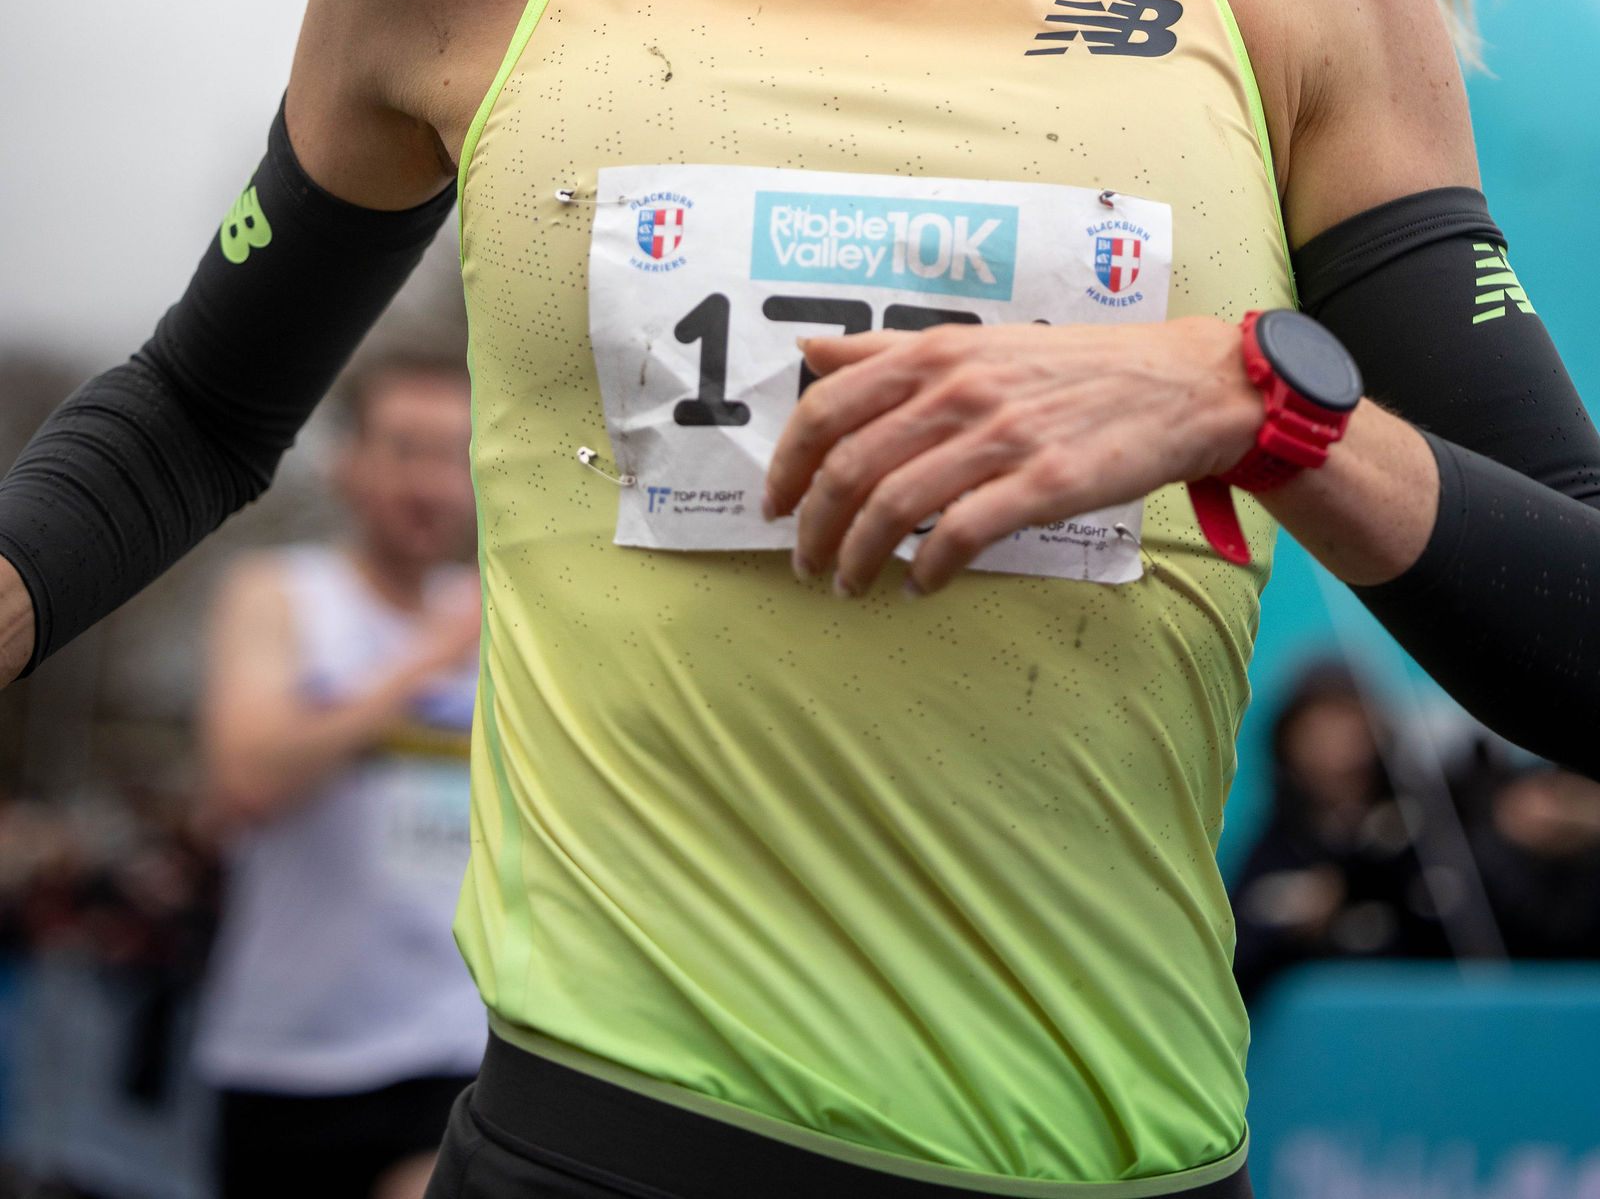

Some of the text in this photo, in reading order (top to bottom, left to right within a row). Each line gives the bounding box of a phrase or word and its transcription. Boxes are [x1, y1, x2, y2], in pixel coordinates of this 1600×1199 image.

[629, 192, 694, 211] BLACKBURN
[771, 205, 888, 241] Ribble
[1086, 220, 1151, 241] BLACKBURN
[887, 211, 1002, 284] 10K
[629, 256, 688, 273] HARRIERS
[1086, 287, 1144, 308] HARRIERS
[673, 490, 745, 502] TOP FLIGHT
[1067, 523, 1108, 538] FLIGHT
